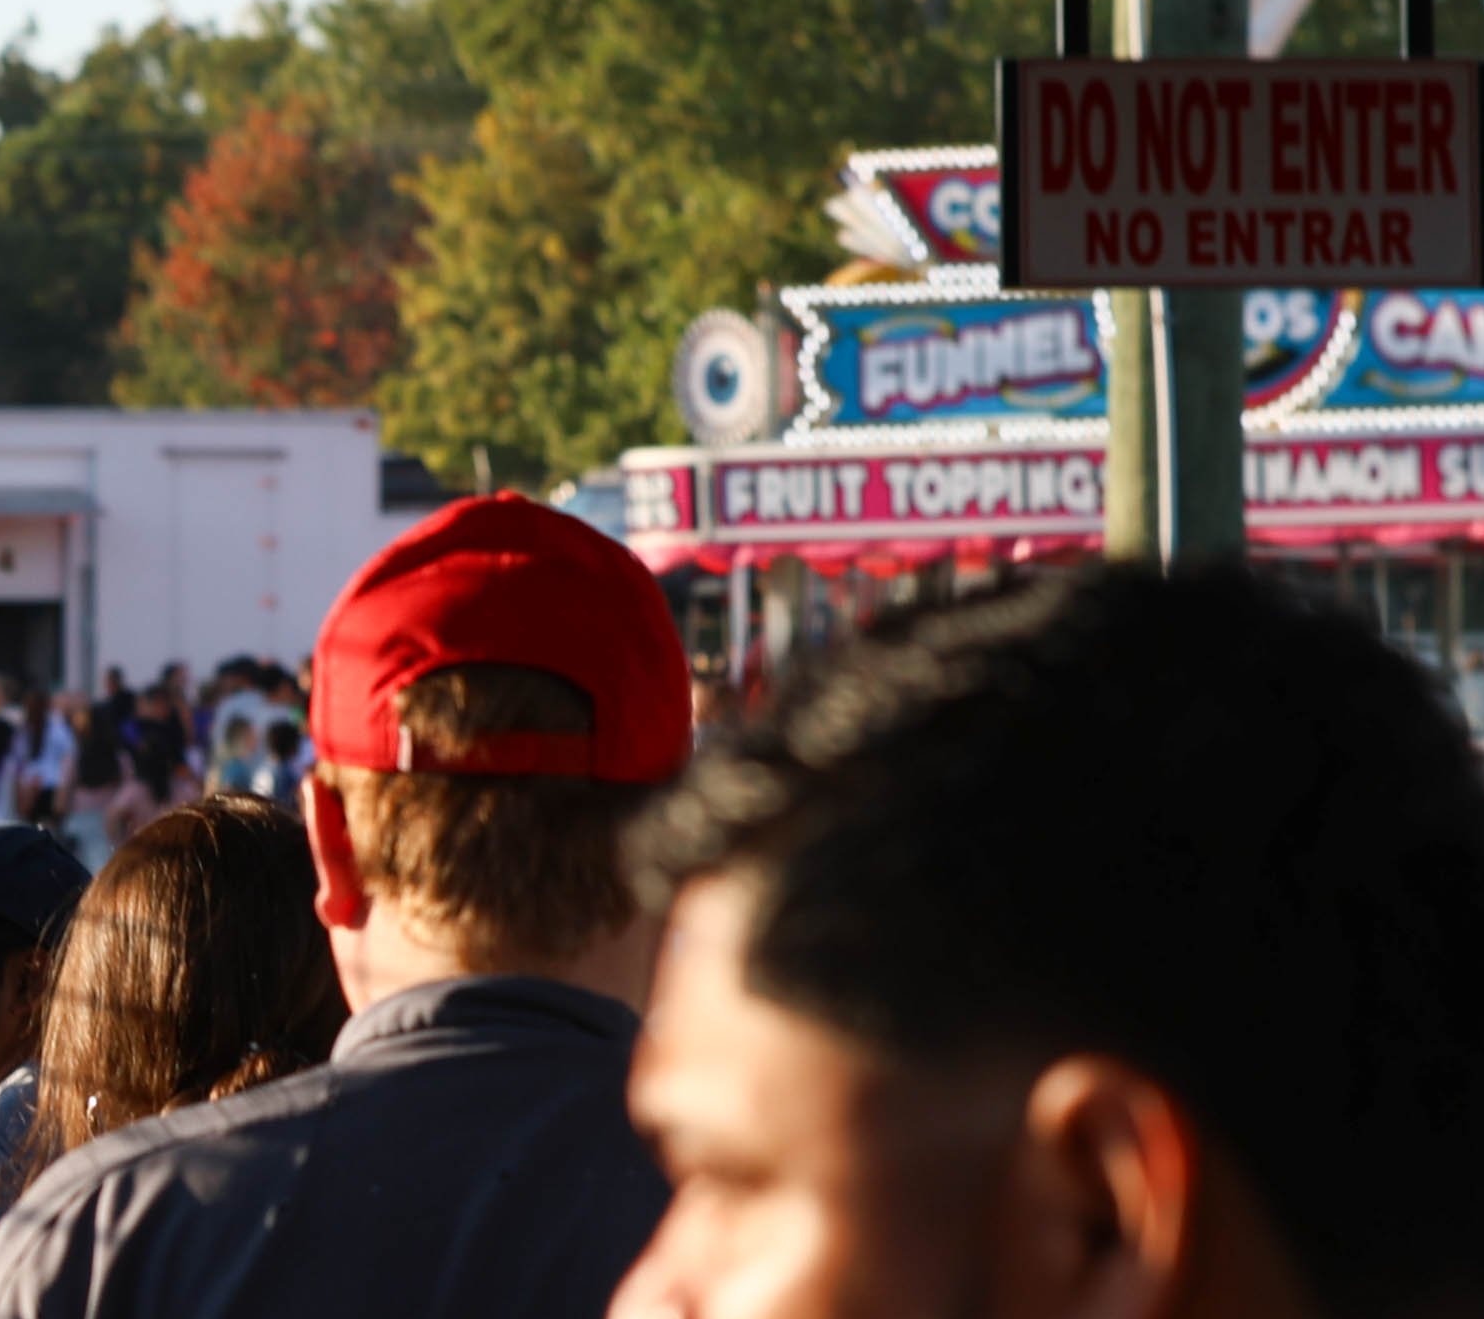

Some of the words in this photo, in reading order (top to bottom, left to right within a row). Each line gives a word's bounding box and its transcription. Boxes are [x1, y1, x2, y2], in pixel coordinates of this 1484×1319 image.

[1038, 80, 1118, 195] DO
[1136, 80, 1252, 195] NOT
[1270, 78, 1459, 195] ENTER
[1084, 209, 1165, 268] NO
[1185, 209, 1414, 268] ENTRAR
[859, 308, 1098, 413] FUNNEL
[722, 462, 868, 523] FRUIT
[884, 454, 1107, 518] TOPPING
